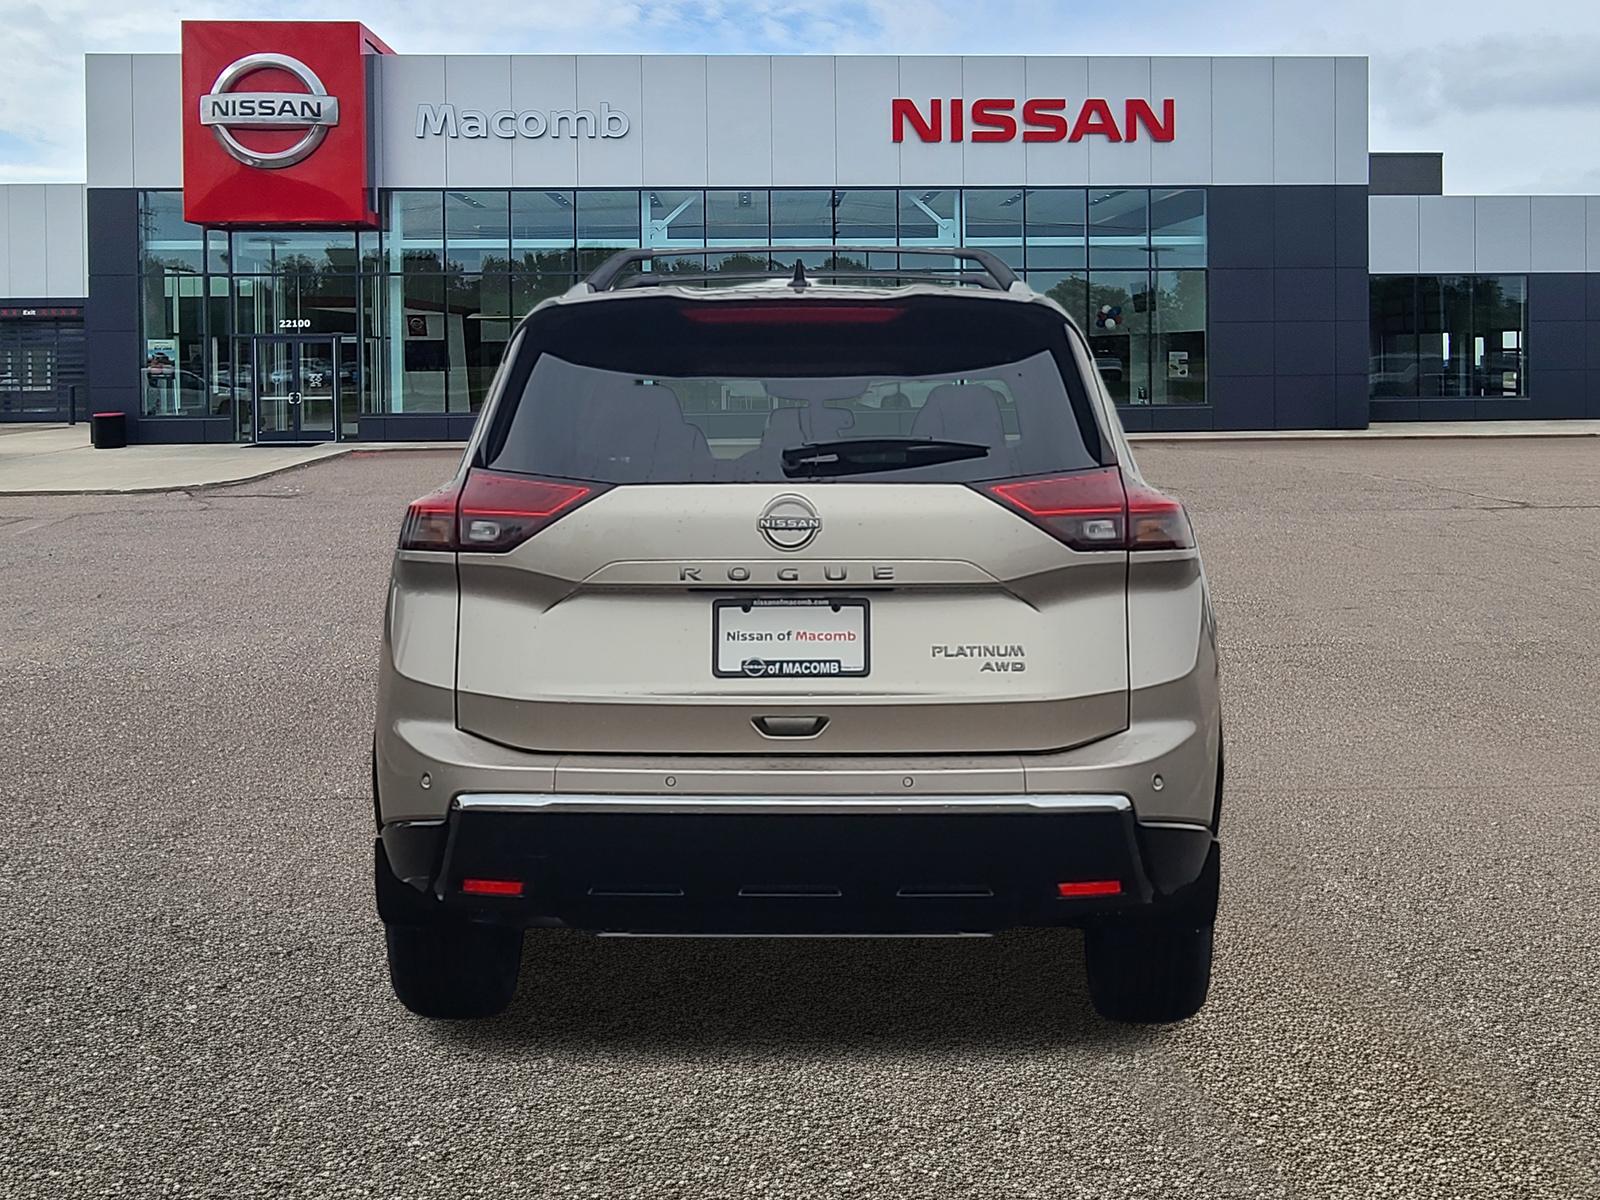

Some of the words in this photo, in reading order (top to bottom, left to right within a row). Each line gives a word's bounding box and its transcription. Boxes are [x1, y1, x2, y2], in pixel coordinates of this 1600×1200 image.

[212, 100, 322, 117] NISSAN
[415, 102, 630, 138] Macomb
[892, 98, 1175, 142] NISSAN
[279, 319, 311, 328] 22100
[760, 519, 820, 528] NISSAN
[679, 566, 895, 581] ROGUE
[726, 631, 773, 641] Nissan
[777, 631, 792, 641] of
[795, 631, 857, 641] Macomb
[931, 645, 1025, 657] PLATINUM
[767, 663, 780, 674] of
[782, 663, 839, 674] MACOMB
[980, 661, 1026, 672] AWD
